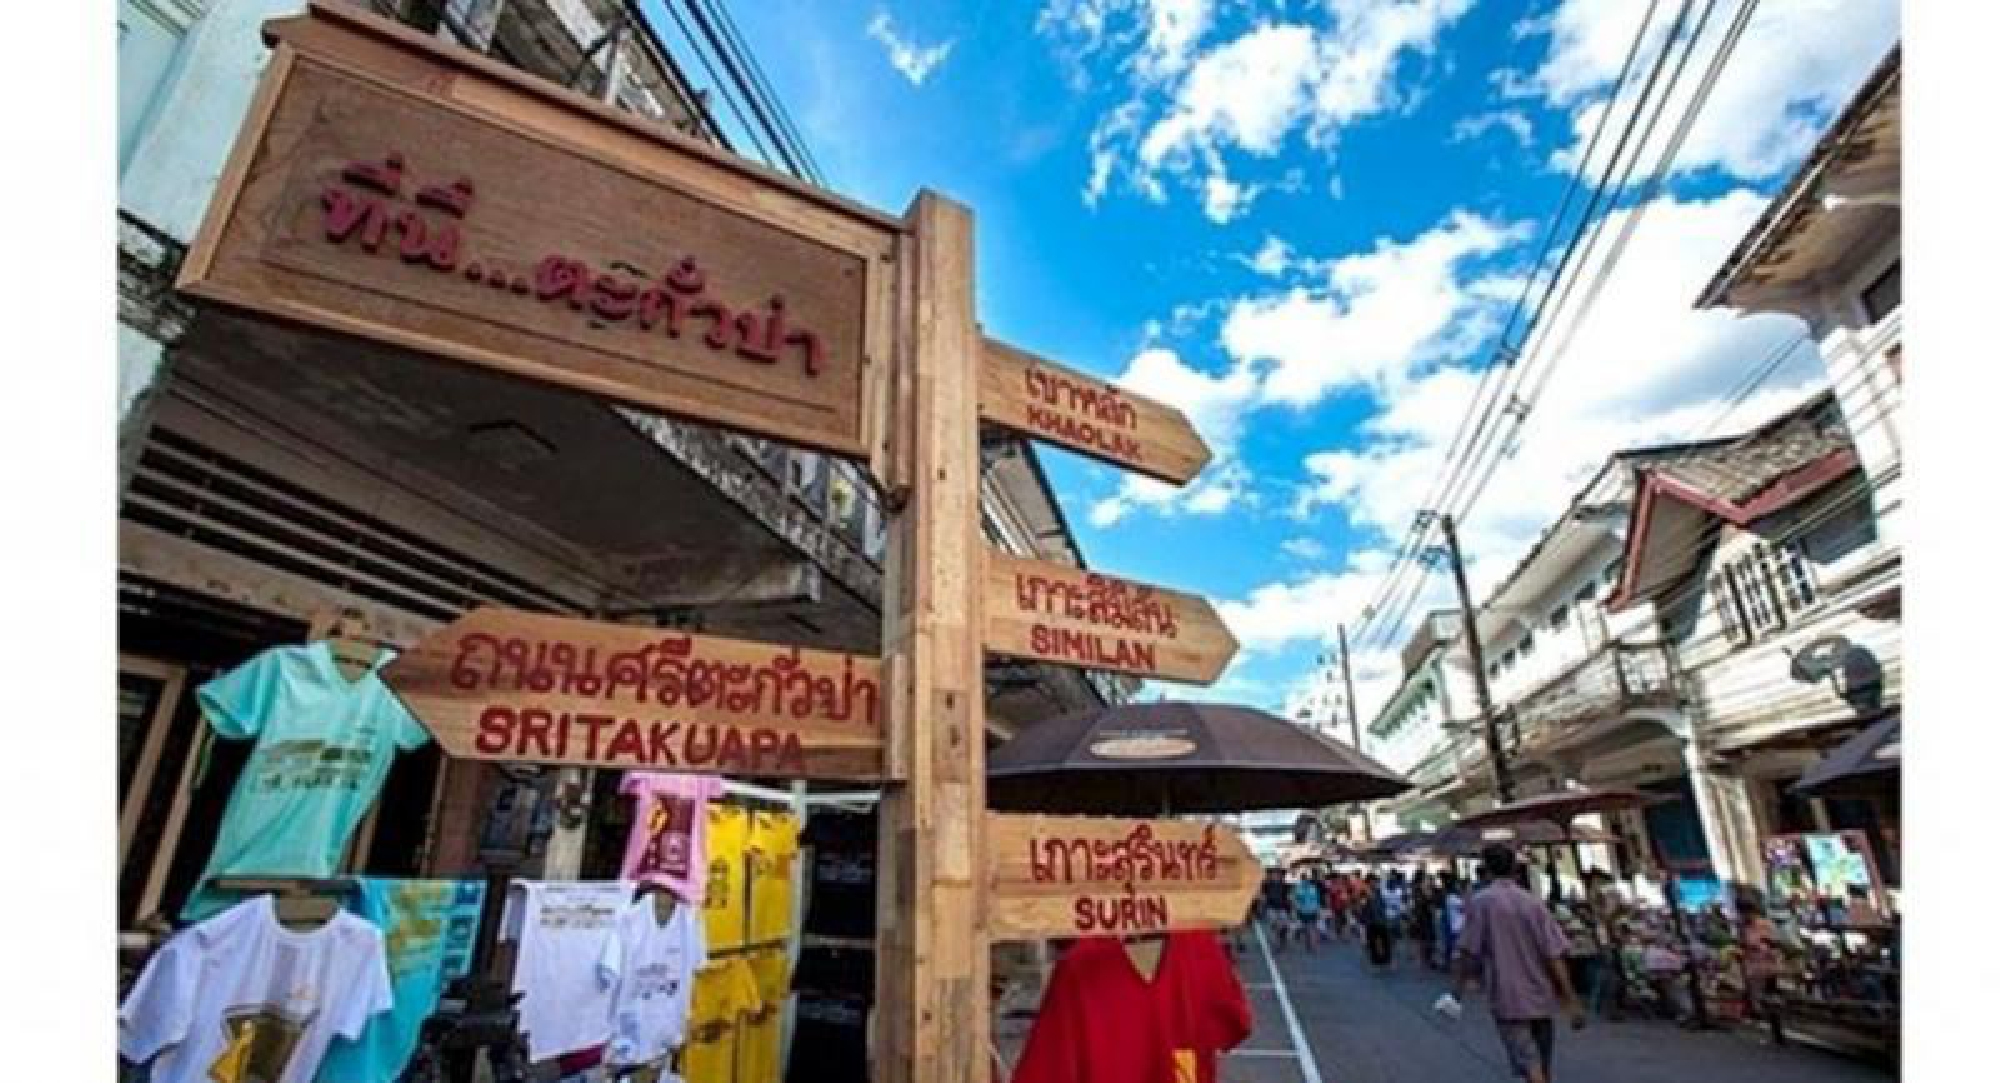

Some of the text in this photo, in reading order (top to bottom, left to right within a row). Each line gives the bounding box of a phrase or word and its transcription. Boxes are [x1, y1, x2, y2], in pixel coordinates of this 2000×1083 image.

[1026, 404, 1142, 460] KHAOLAK
[1031, 624, 1156, 672] SIMILAN
[451, 632, 880, 726] ถนนศรีตะกั่วป่า
[475, 706, 803, 770] SRITAKUAPA
[1075, 894, 1168, 930] SURIN
